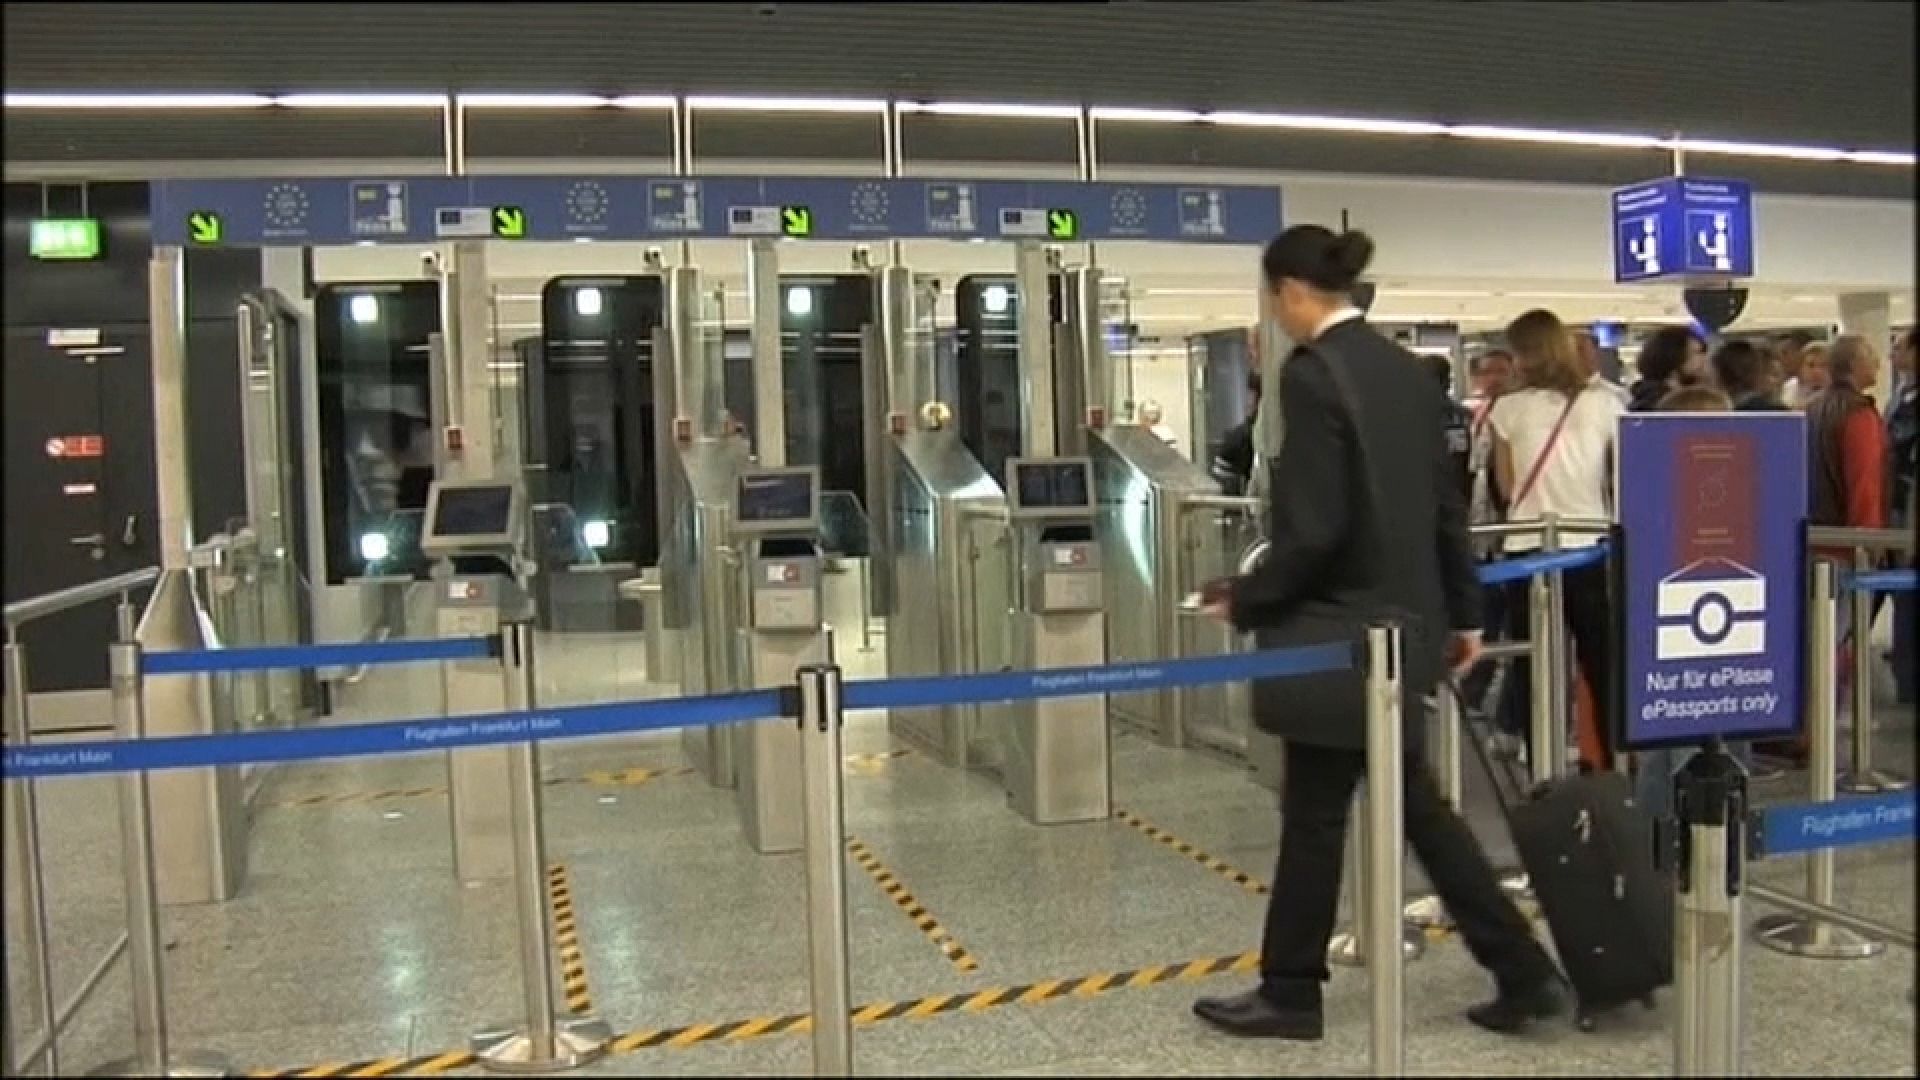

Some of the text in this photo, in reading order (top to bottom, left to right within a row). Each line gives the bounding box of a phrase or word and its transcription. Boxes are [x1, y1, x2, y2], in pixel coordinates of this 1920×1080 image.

[1646, 671, 1680, 692] Nur
[1642, 692, 1779, 720] ePassports only
